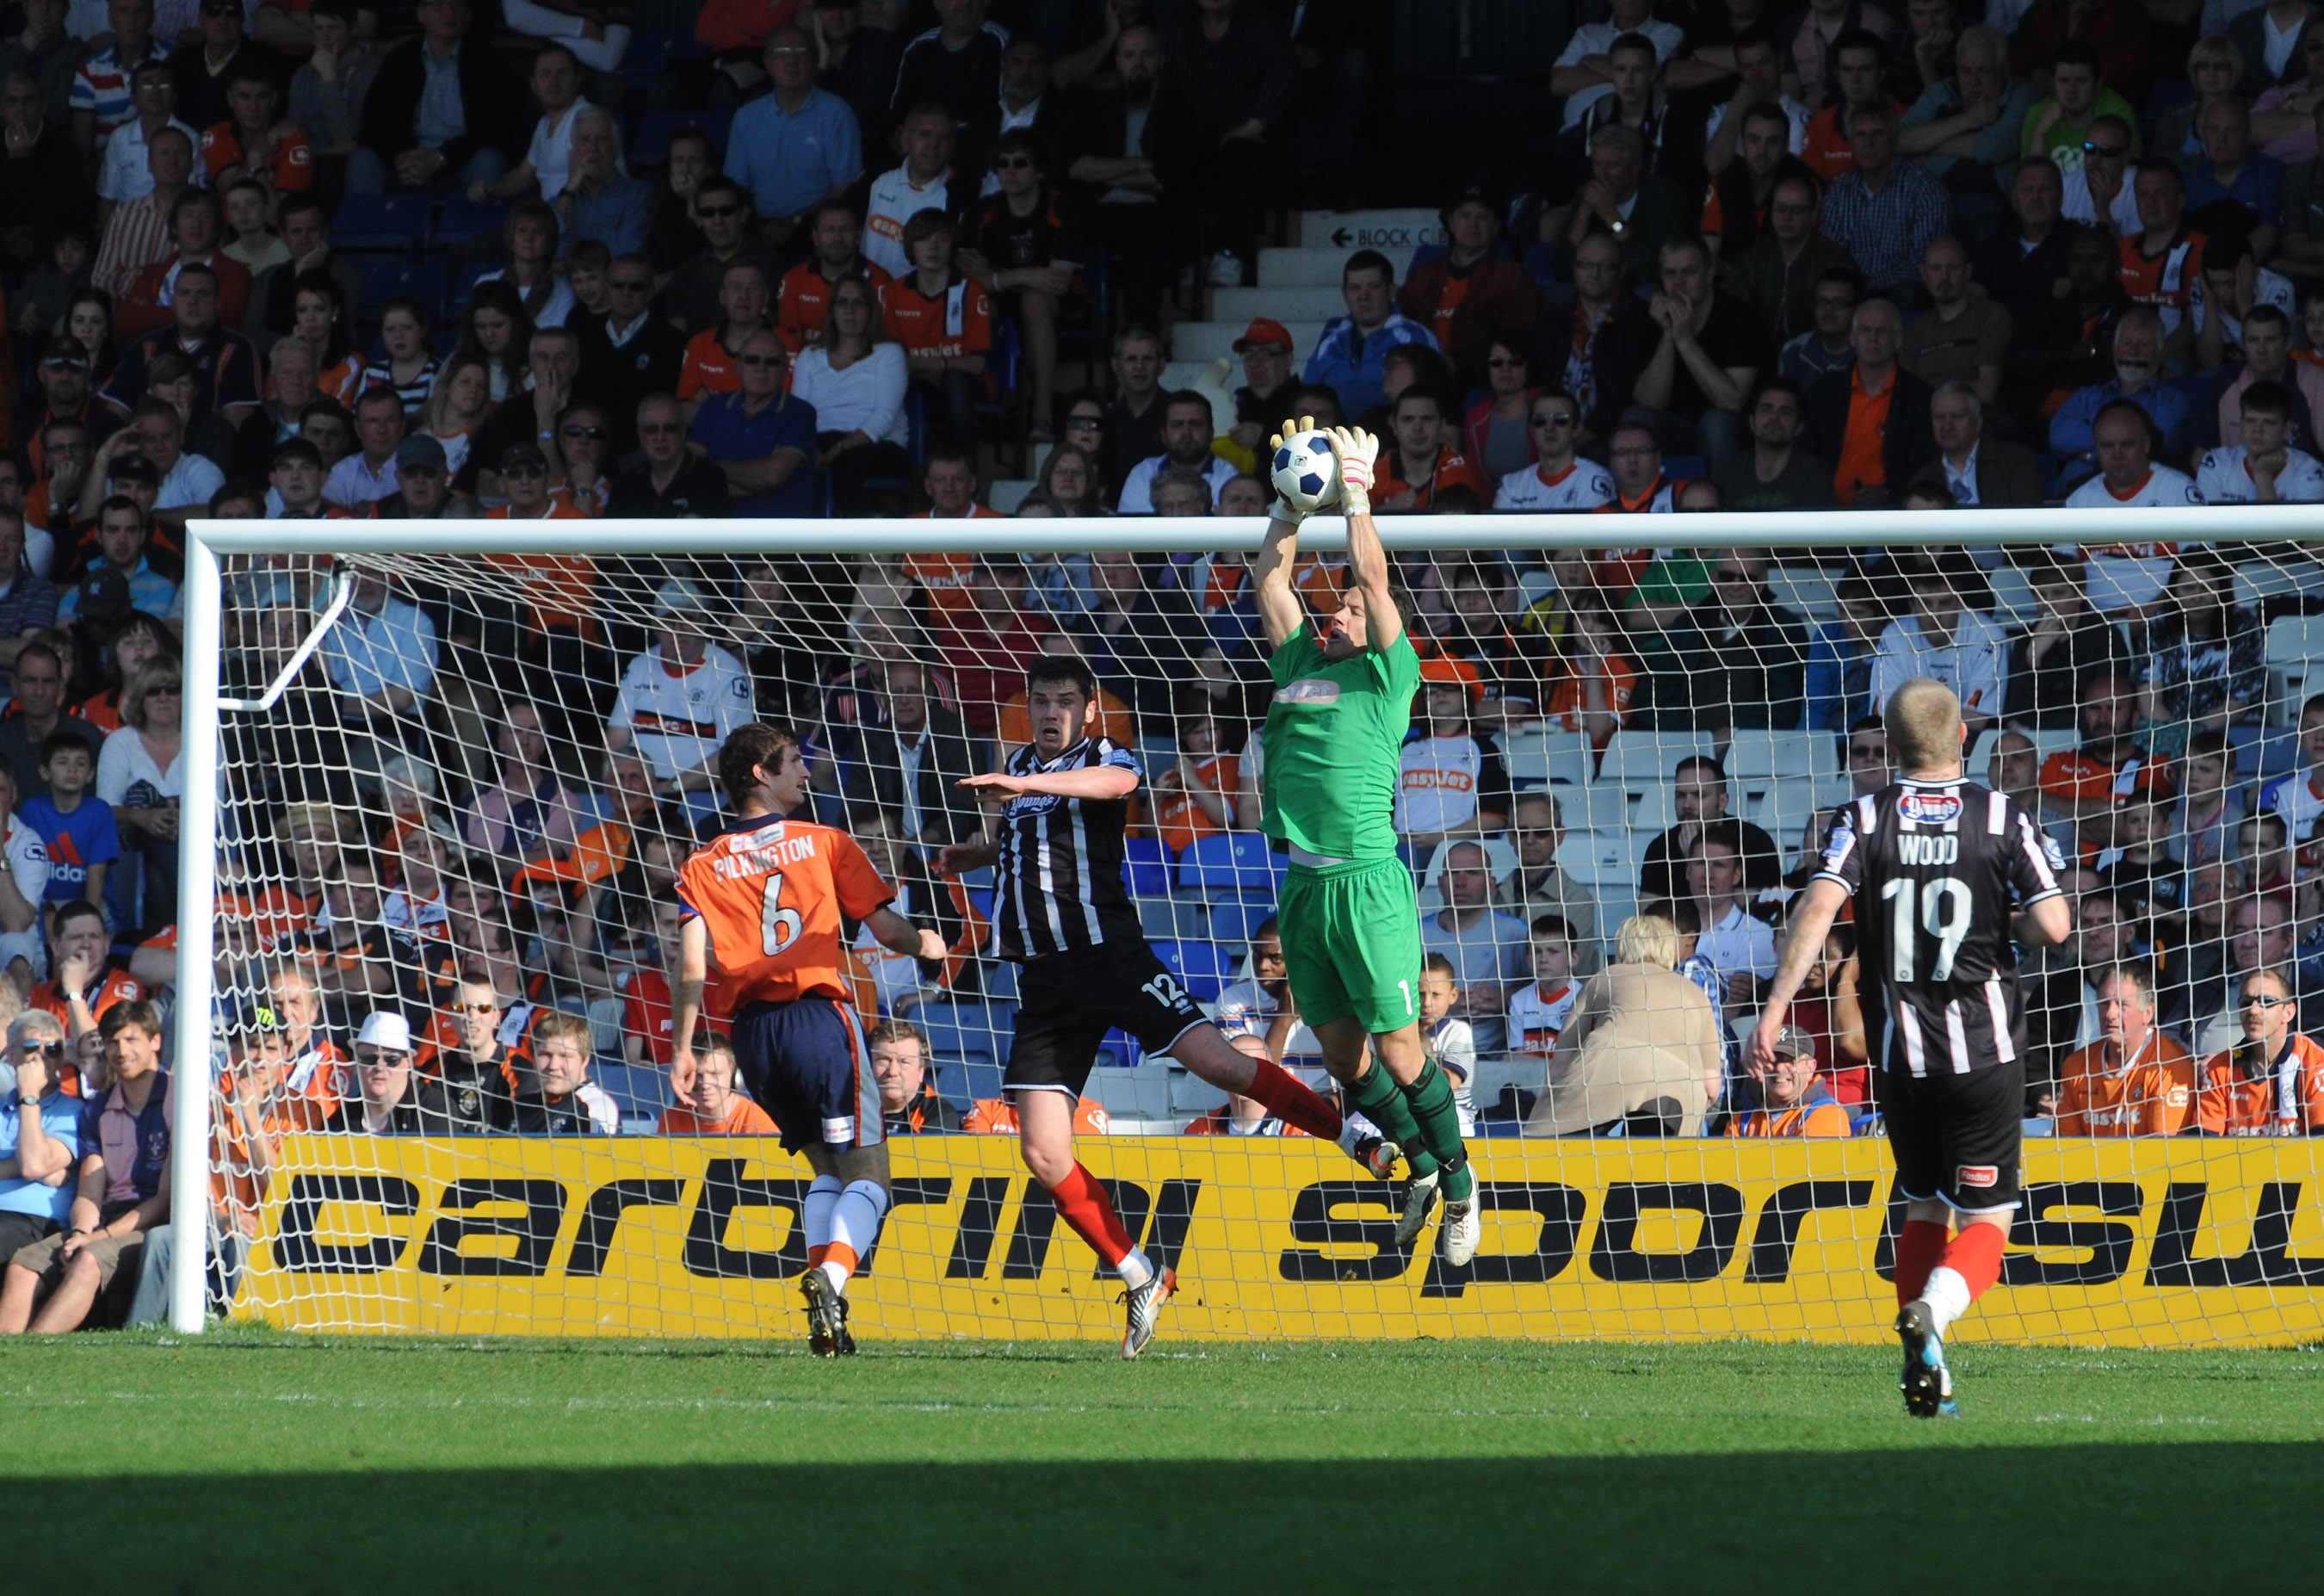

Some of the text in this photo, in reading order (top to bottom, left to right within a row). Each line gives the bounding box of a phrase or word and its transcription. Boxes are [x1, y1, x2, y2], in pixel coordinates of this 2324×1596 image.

[1359, 229, 1411, 245] BLOCK
[1419, 228, 1431, 244] C
[1277, 680, 1332, 702] syJet
[1403, 770, 1469, 789] easyJet
[714, 835, 816, 882] PILKINGTON
[1897, 834, 1959, 866] WOOD
[761, 871, 803, 957] 6
[1882, 877, 1973, 982] 19
[1141, 974, 1186, 1008] 12
[1398, 979, 1412, 1017] 1
[1962, 1172, 1991, 1183] Findus
[1279, 1180, 2324, 1298] sporsw
